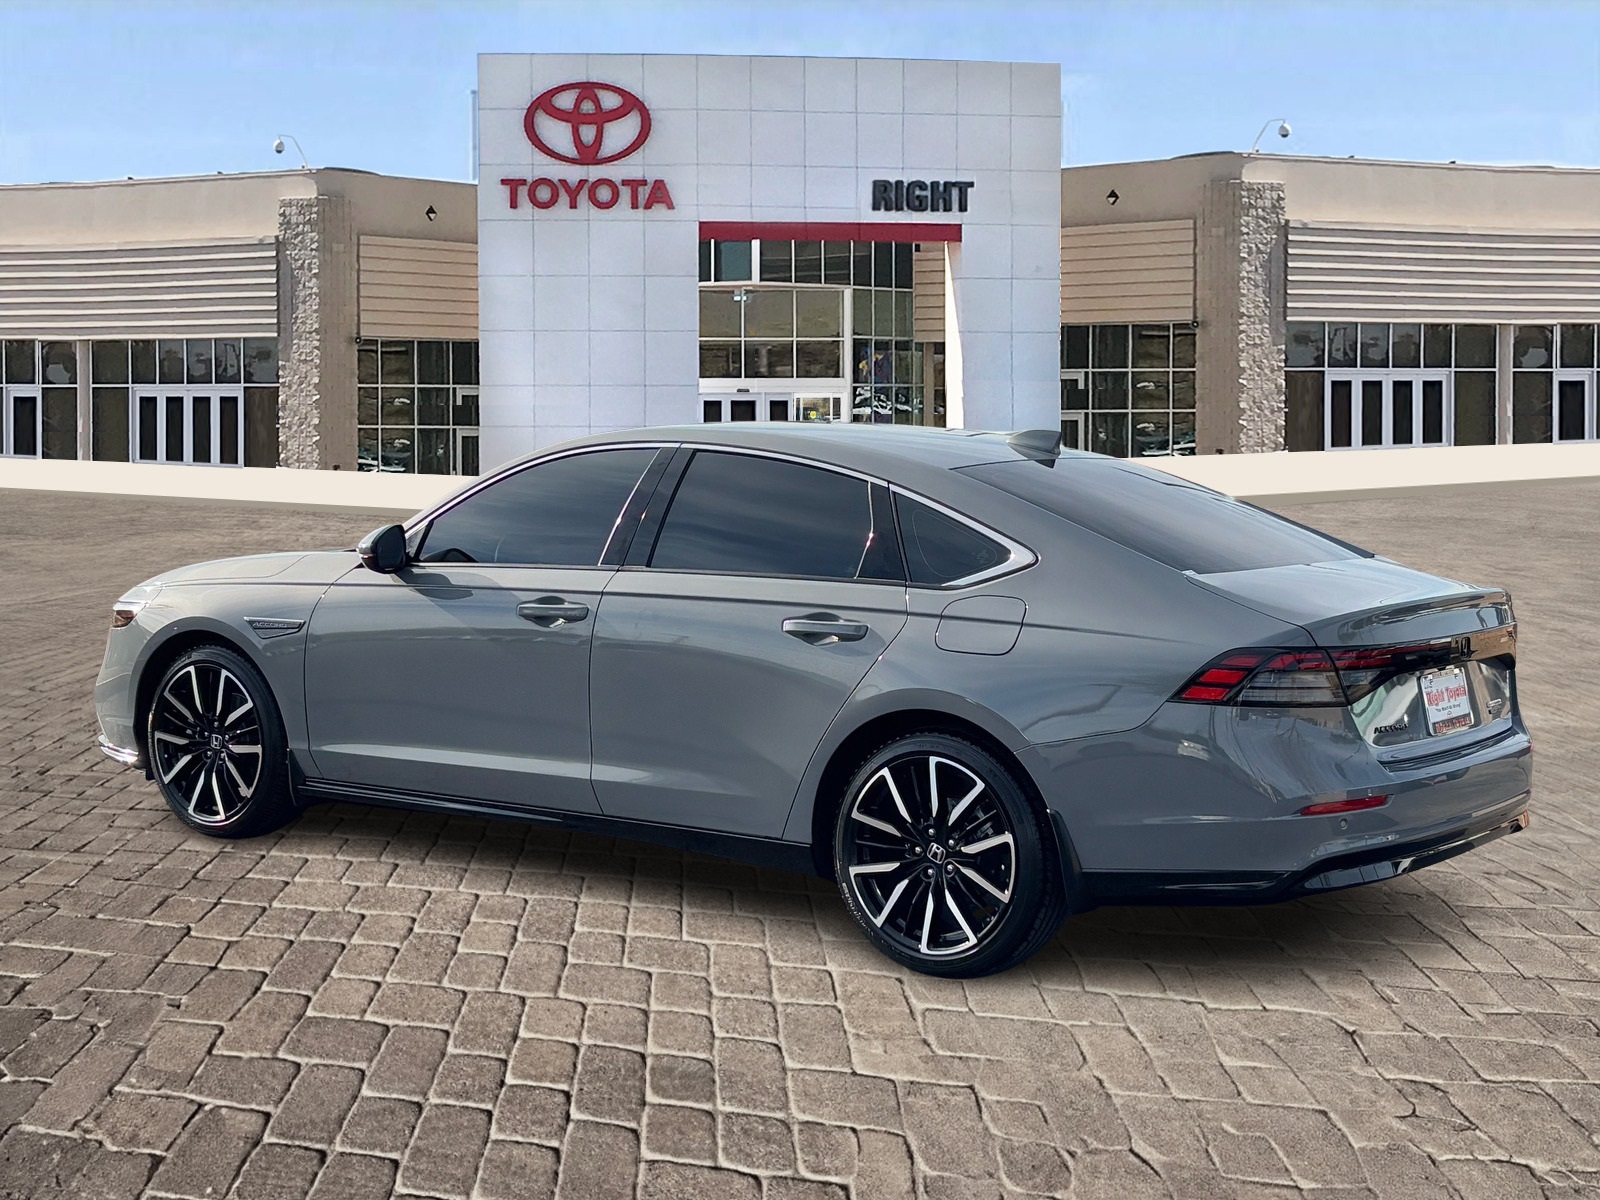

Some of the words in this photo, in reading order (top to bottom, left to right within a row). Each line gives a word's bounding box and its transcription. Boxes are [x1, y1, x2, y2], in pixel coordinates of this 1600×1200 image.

[500, 178, 675, 209] TOYOTA
[872, 180, 975, 212] RIGHT
[1425, 688, 1445, 707] Right
[1445, 684, 1466, 702] Toyota
